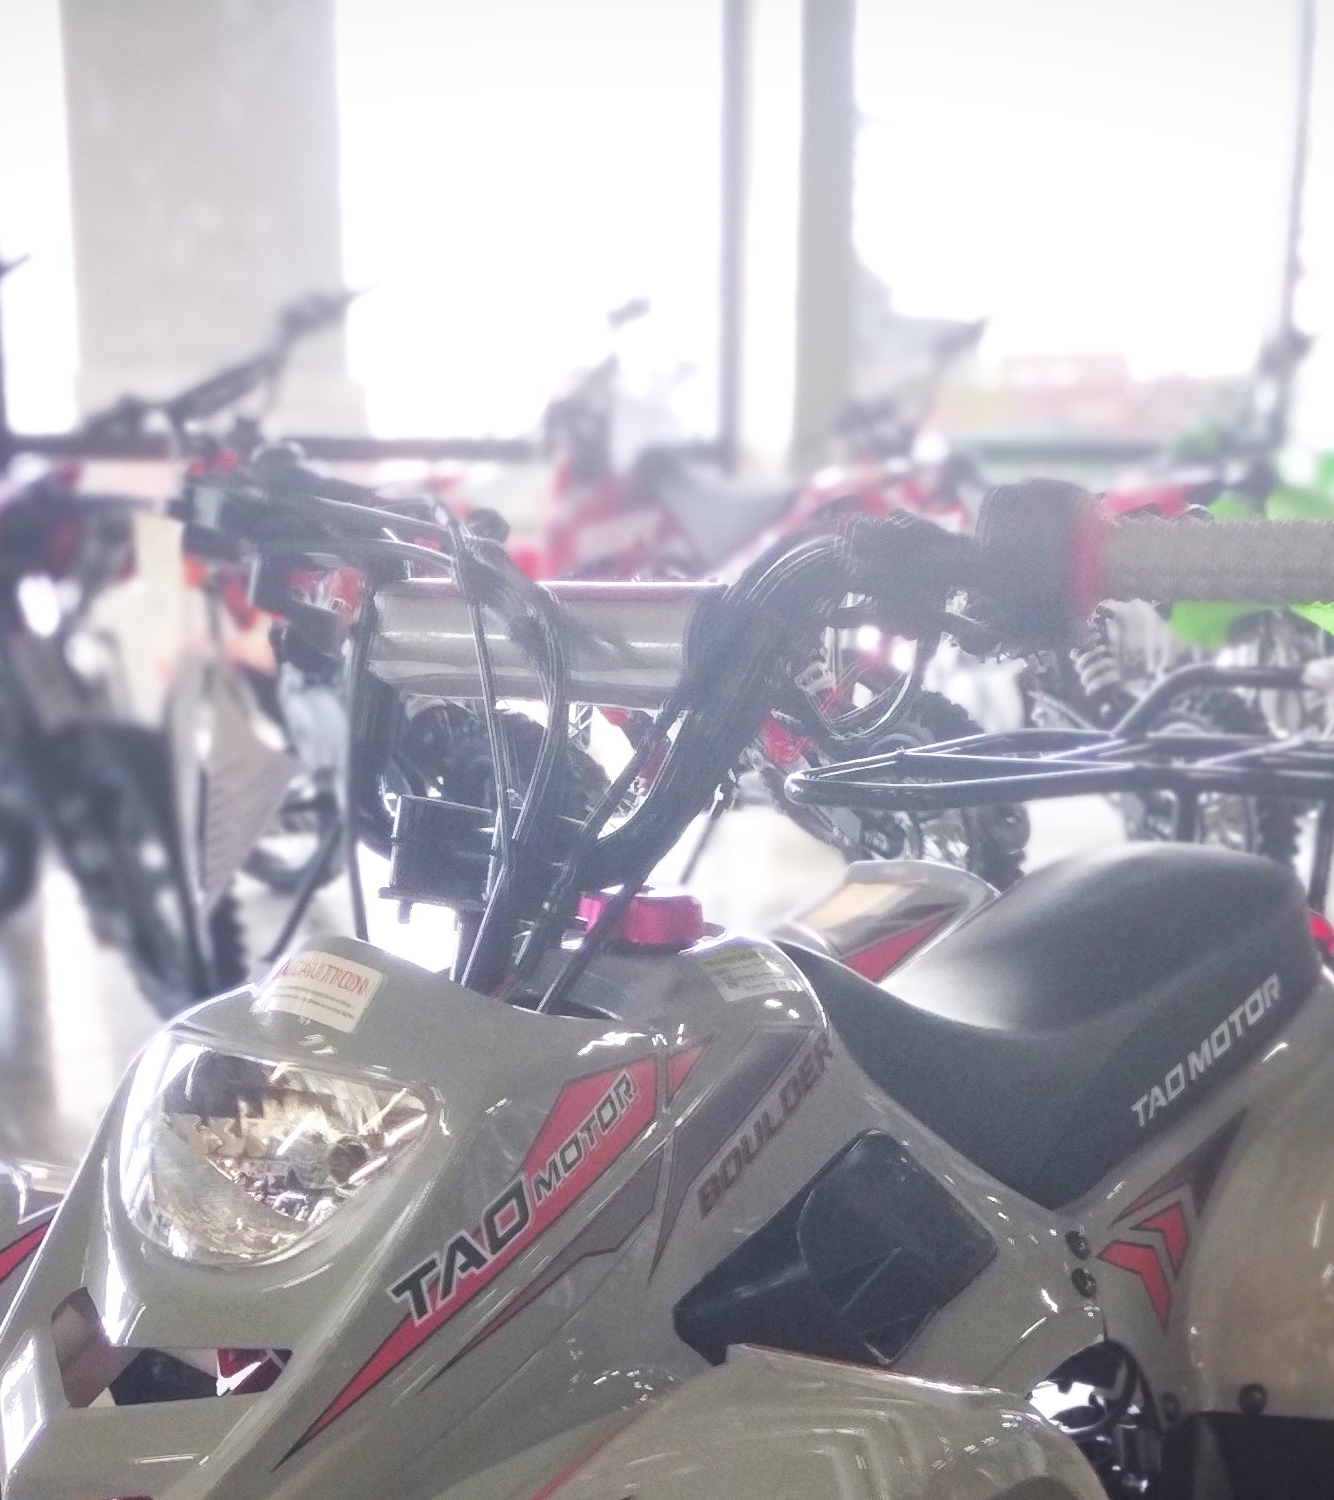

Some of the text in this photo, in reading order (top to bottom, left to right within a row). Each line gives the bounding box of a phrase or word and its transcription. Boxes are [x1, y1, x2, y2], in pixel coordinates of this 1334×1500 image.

[294, 959, 370, 997] CAUTION
[387, 1068, 638, 1327] TAO MOTOR
[697, 1031, 834, 1221] BOULDER
